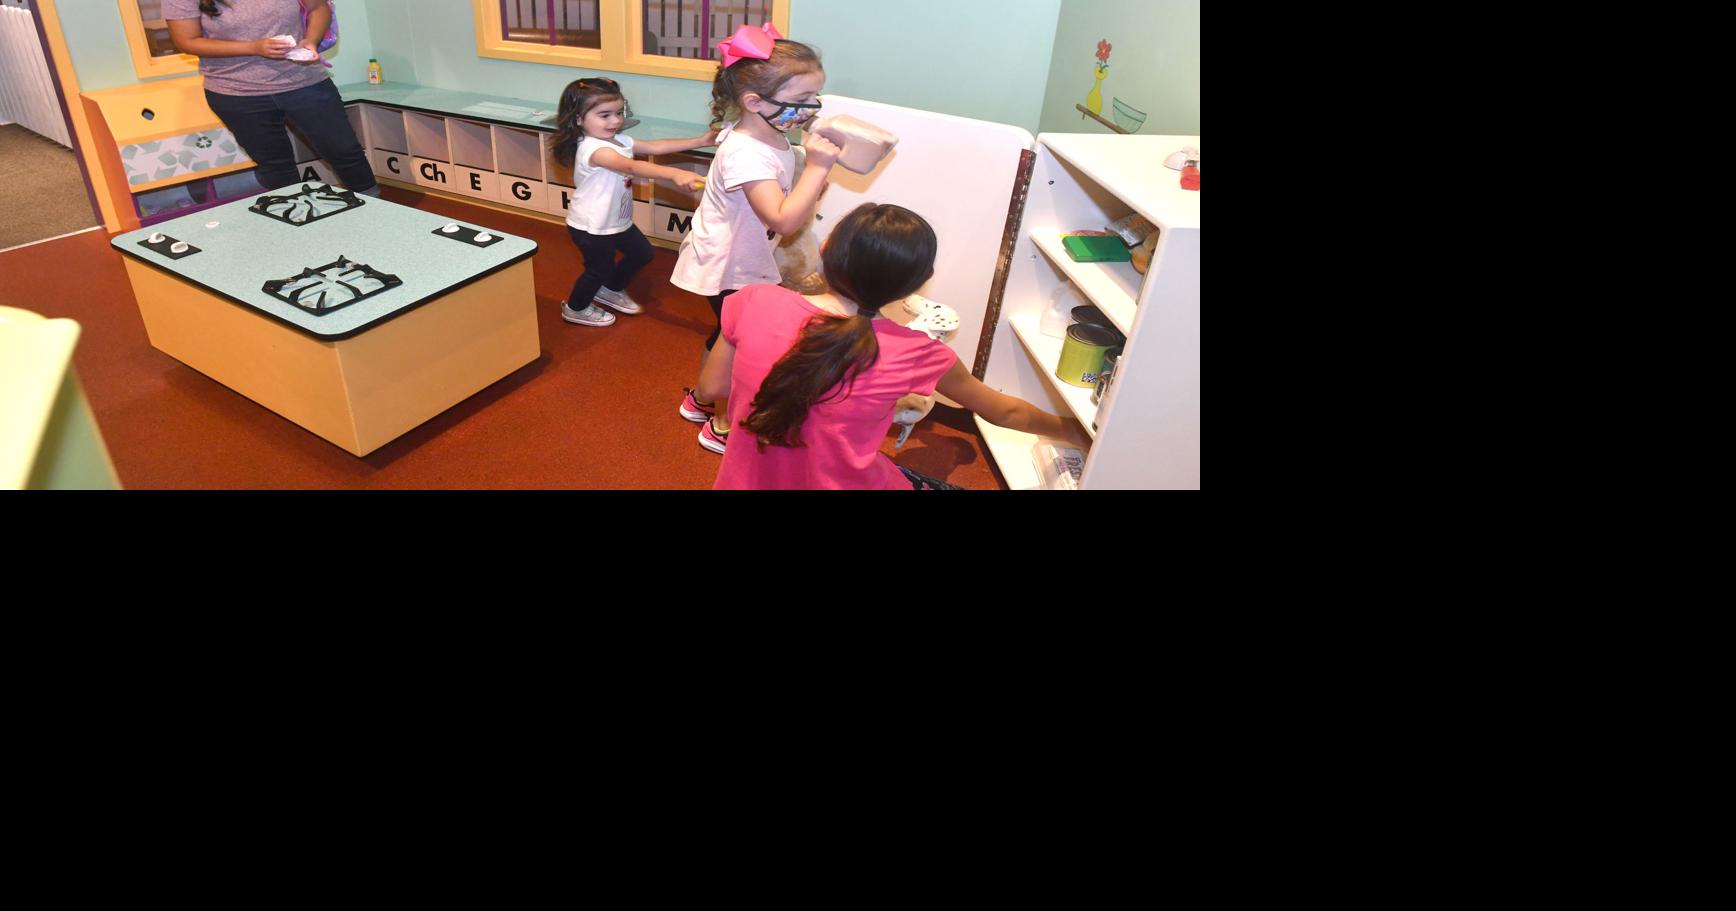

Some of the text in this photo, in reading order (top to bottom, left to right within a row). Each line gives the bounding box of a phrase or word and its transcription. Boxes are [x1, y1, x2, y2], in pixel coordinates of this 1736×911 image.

[301, 165, 322, 182] A
[386, 156, 401, 174] C
[420, 162, 447, 183] Ch
[469, 173, 482, 191] E
[511, 181, 532, 201] G
[667, 212, 693, 234] M
